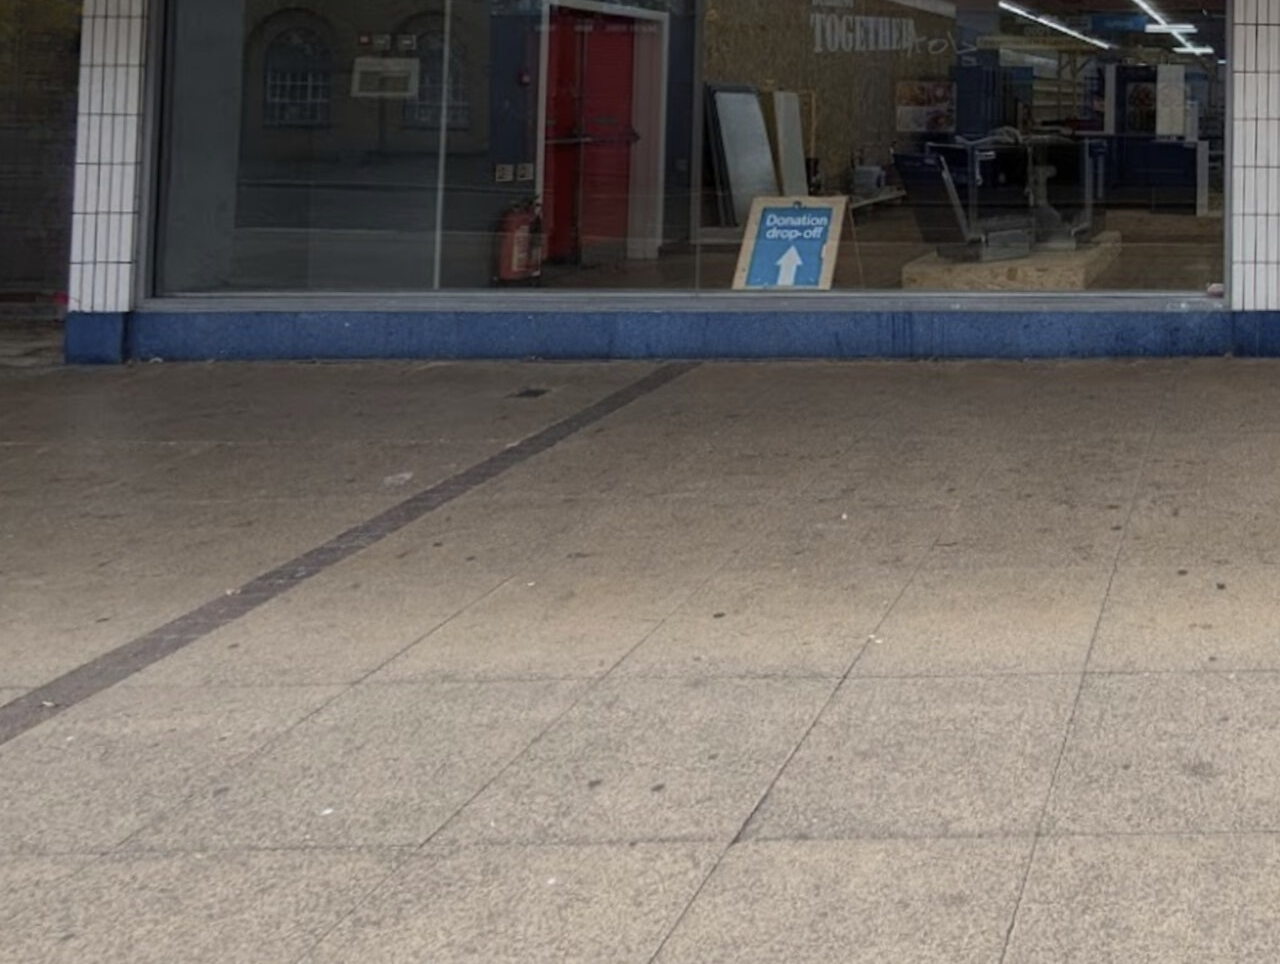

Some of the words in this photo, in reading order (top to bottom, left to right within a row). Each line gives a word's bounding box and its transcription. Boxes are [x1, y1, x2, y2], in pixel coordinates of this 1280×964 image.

[809, 11, 917, 53] TOGETHER
[765, 214, 829, 226] Donation
[765, 226, 825, 240] drop-off
